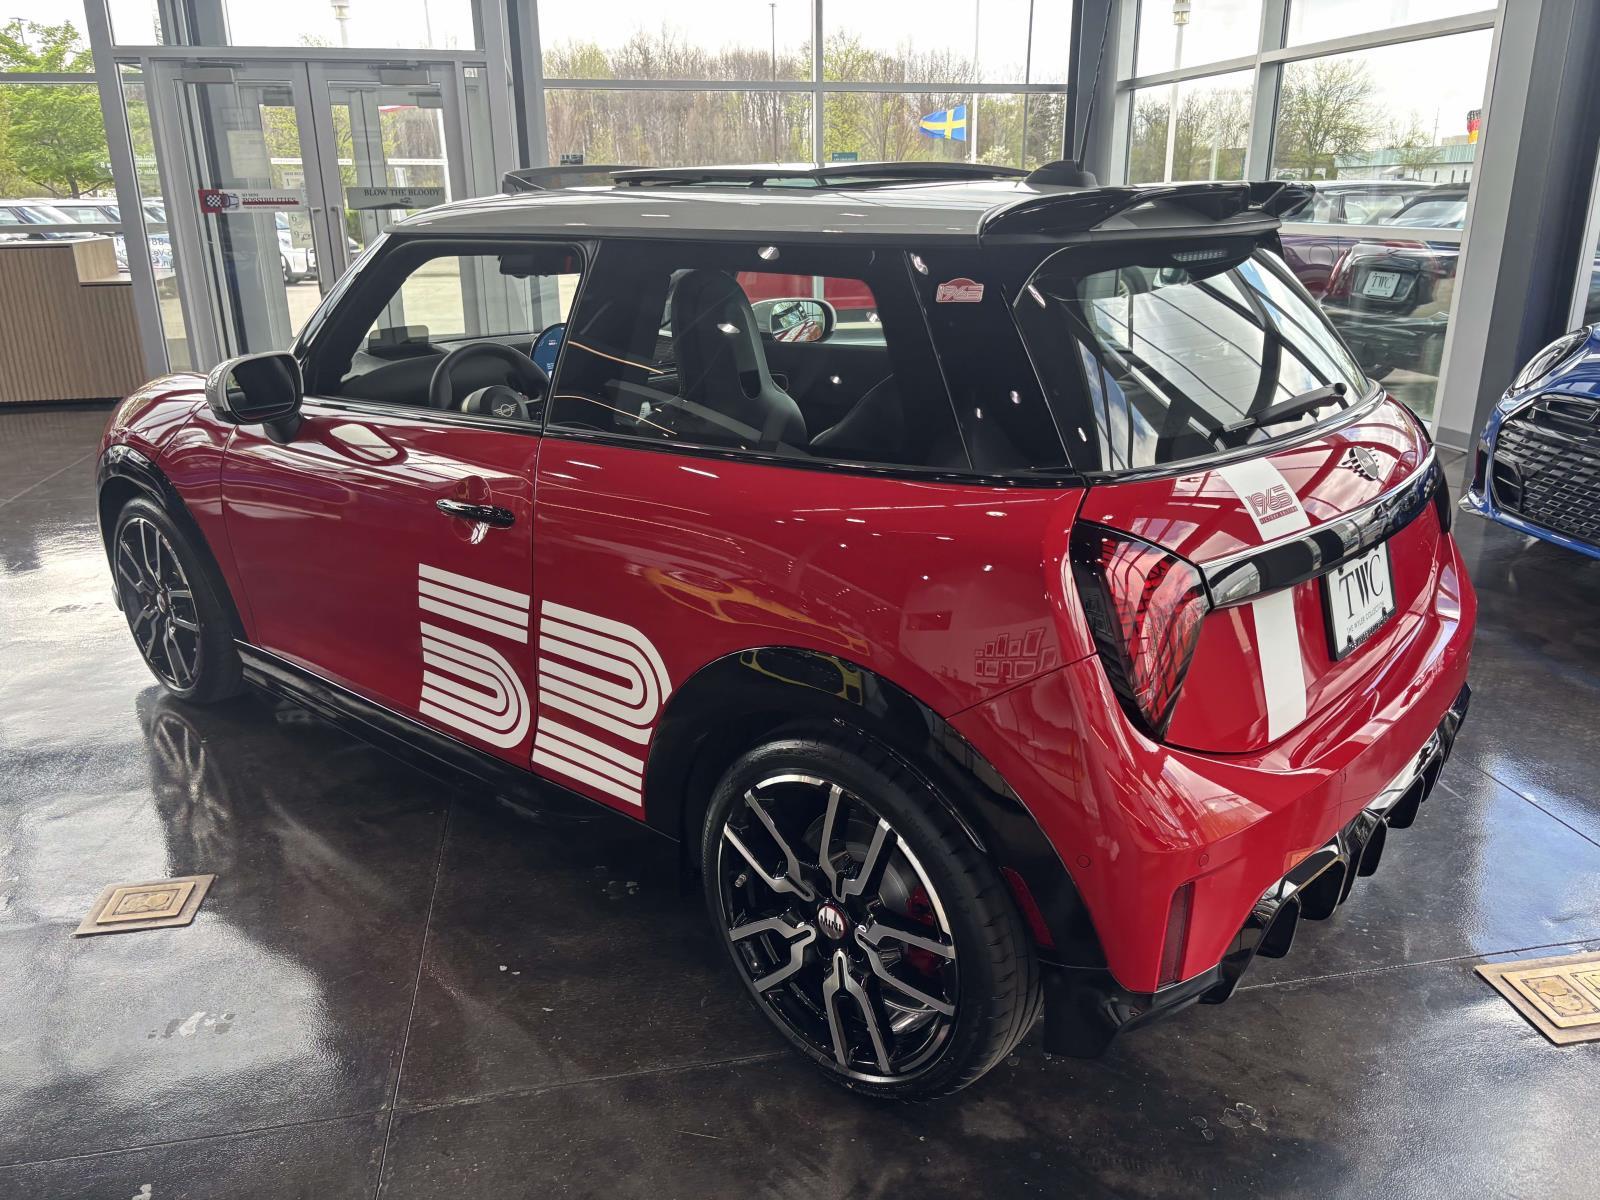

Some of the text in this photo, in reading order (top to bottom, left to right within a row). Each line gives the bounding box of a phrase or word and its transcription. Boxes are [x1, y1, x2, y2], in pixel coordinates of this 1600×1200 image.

[364, 188, 441, 197] BLOW THE BLOODY
[1372, 276, 1394, 288] TWC
[1245, 484, 1293, 517] 1965
[1338, 554, 1384, 619] TWC
